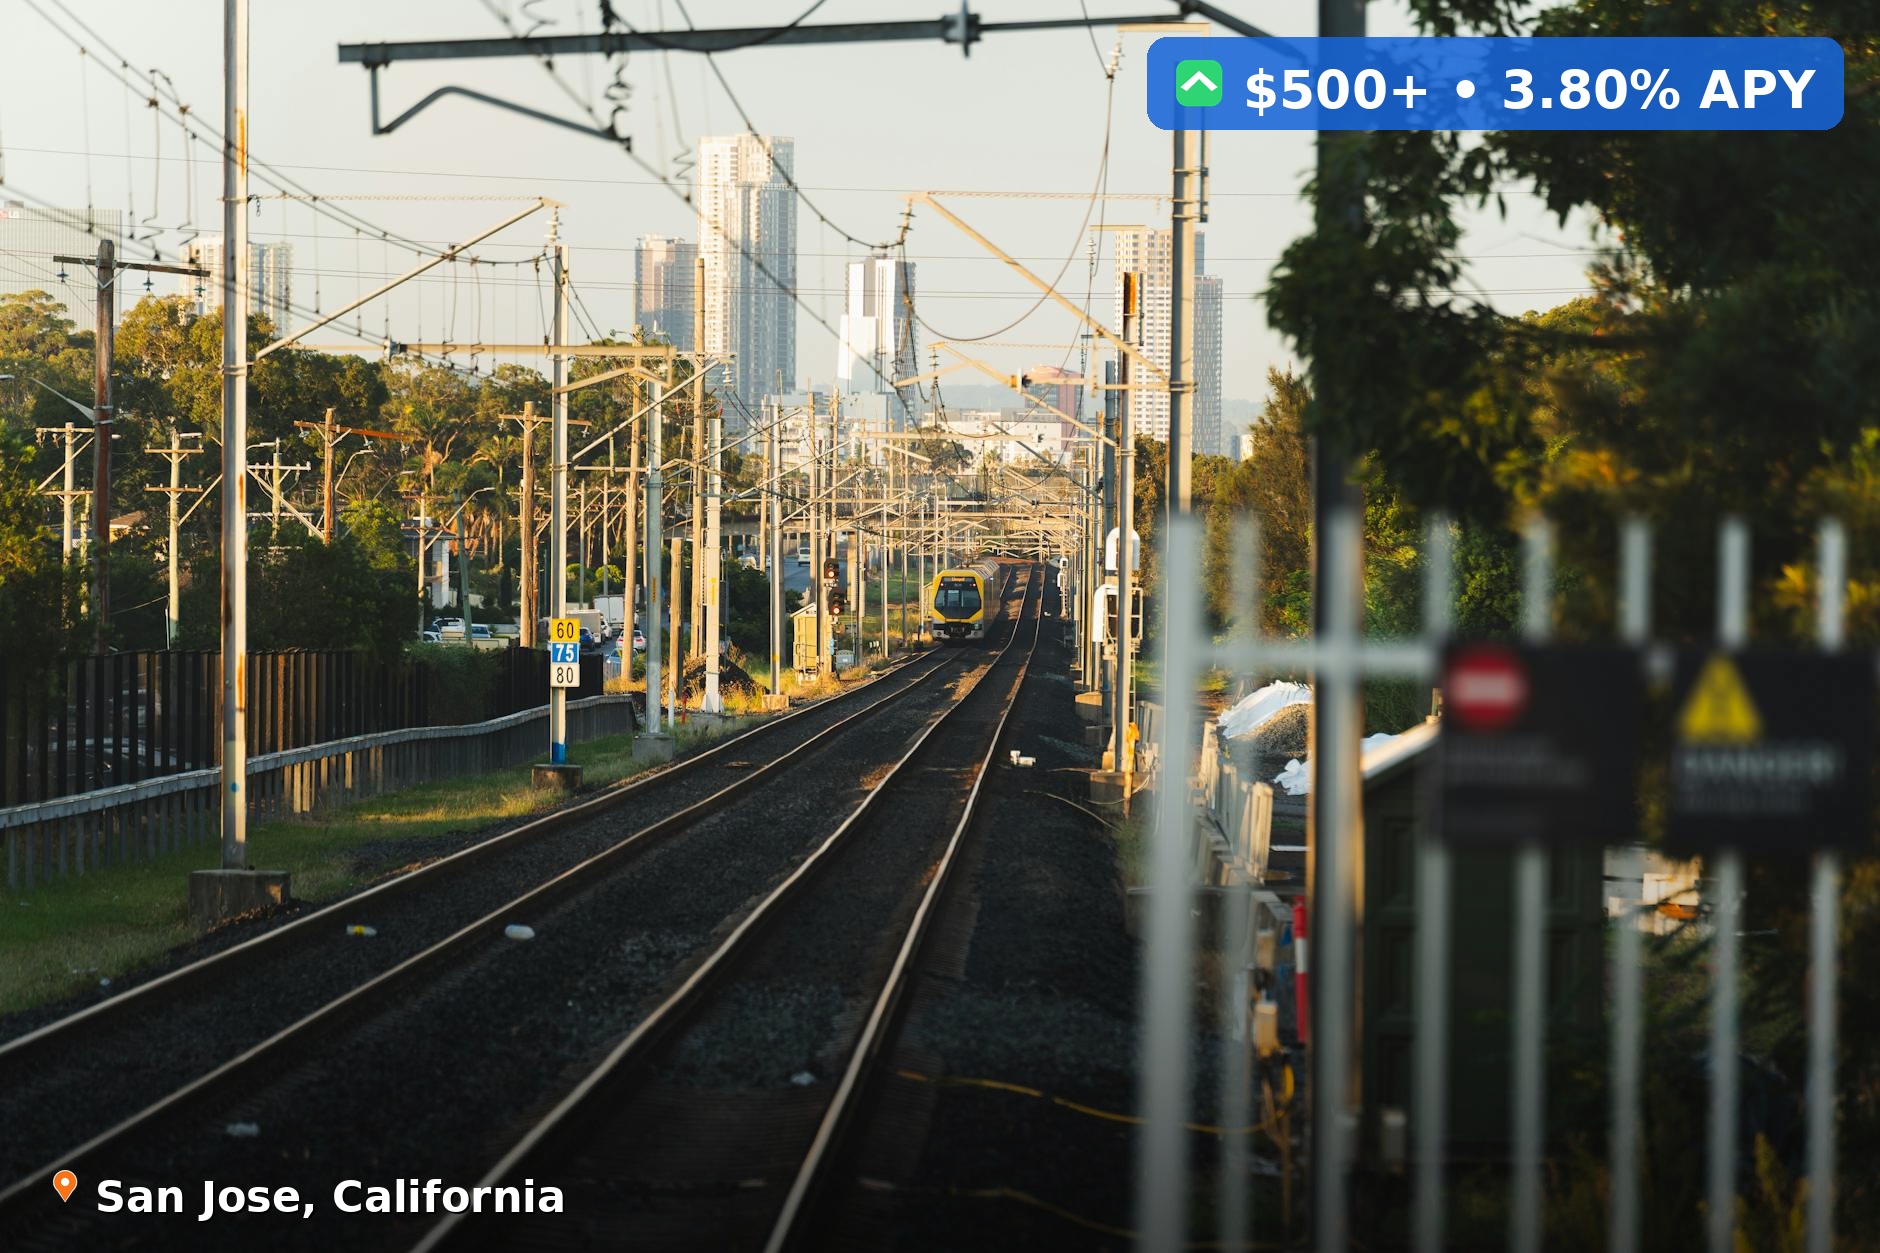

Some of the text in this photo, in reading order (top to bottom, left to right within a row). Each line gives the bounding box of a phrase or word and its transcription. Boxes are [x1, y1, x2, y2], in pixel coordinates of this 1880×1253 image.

[557, 622, 574, 639] 60
[556, 643, 574, 662] 75
[556, 666, 574, 684] 80
